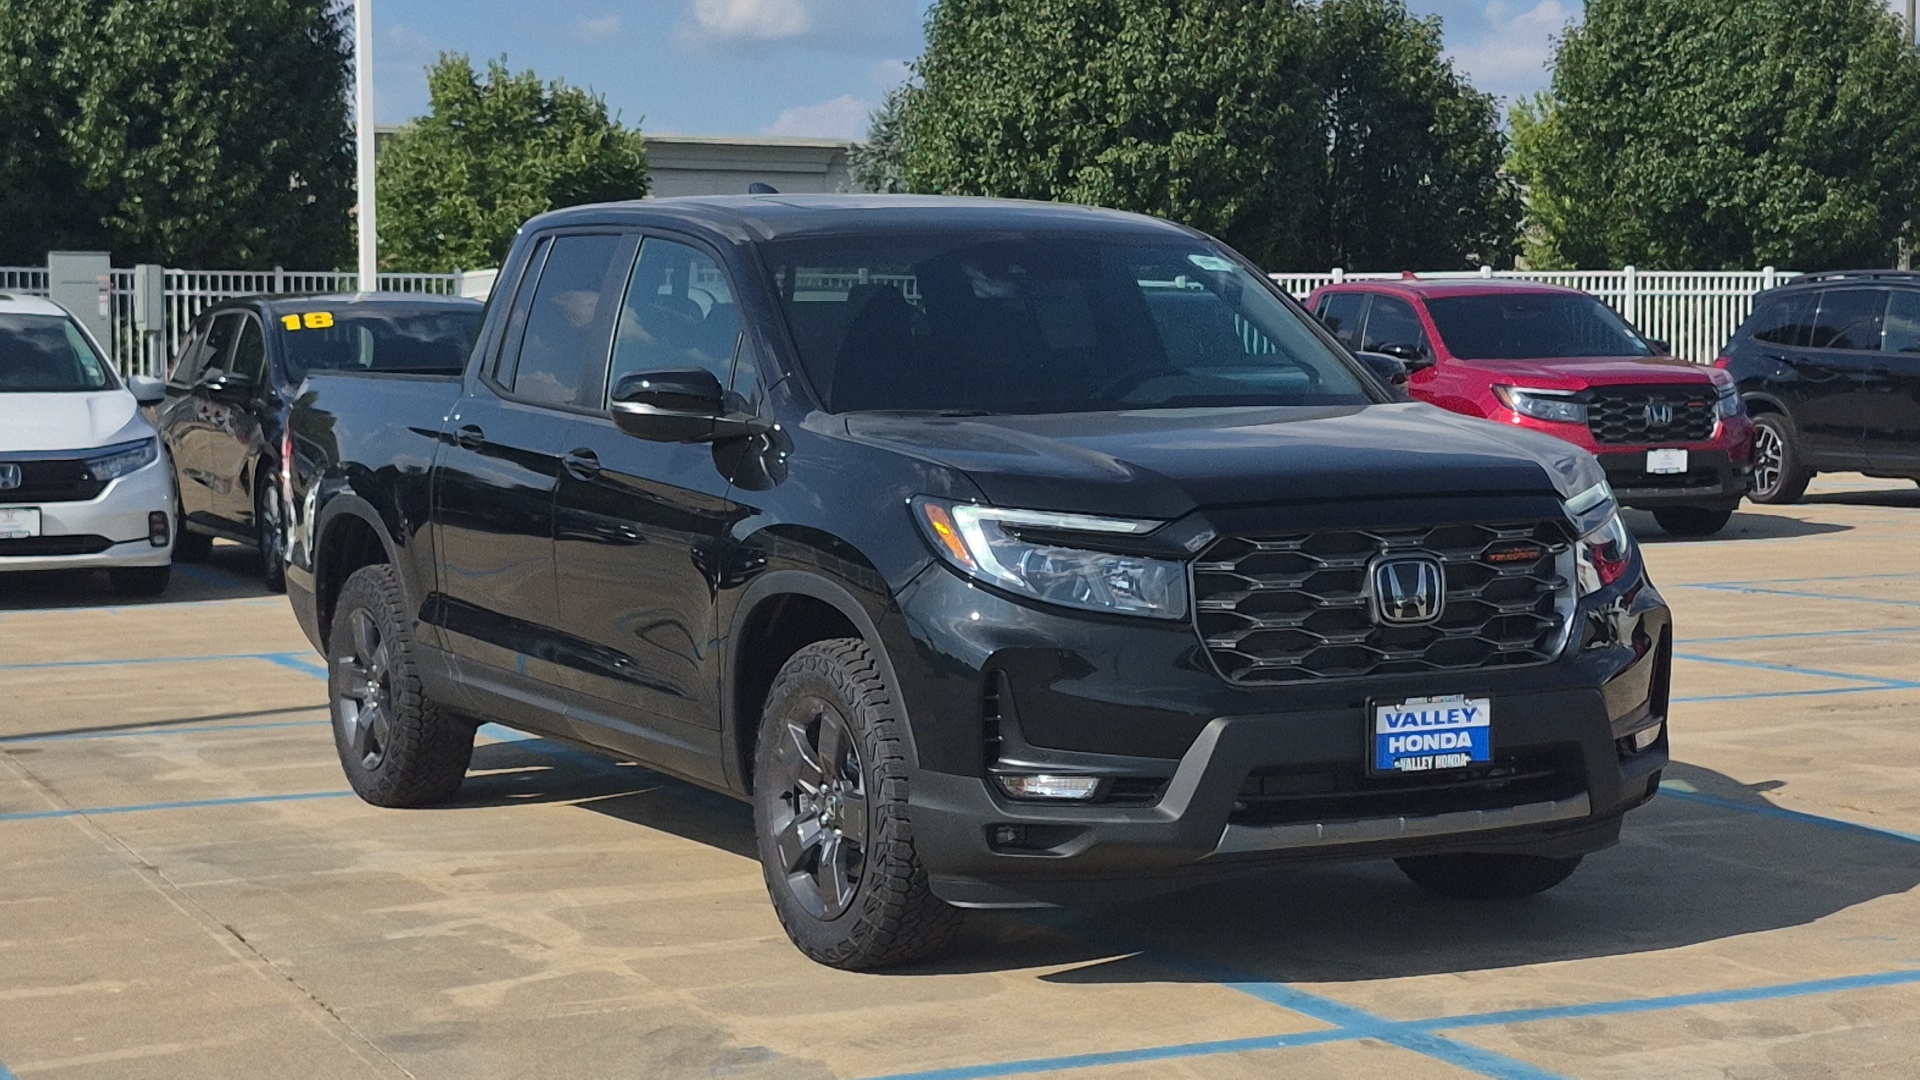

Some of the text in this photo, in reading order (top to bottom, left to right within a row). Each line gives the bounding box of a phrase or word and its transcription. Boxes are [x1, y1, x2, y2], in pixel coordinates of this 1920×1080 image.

[281, 311, 334, 331] 18
[1385, 707, 1477, 729] VALLEY
[1389, 731, 1473, 754] HONDA
[1400, 753, 1468, 772] VALLEY HONDA
